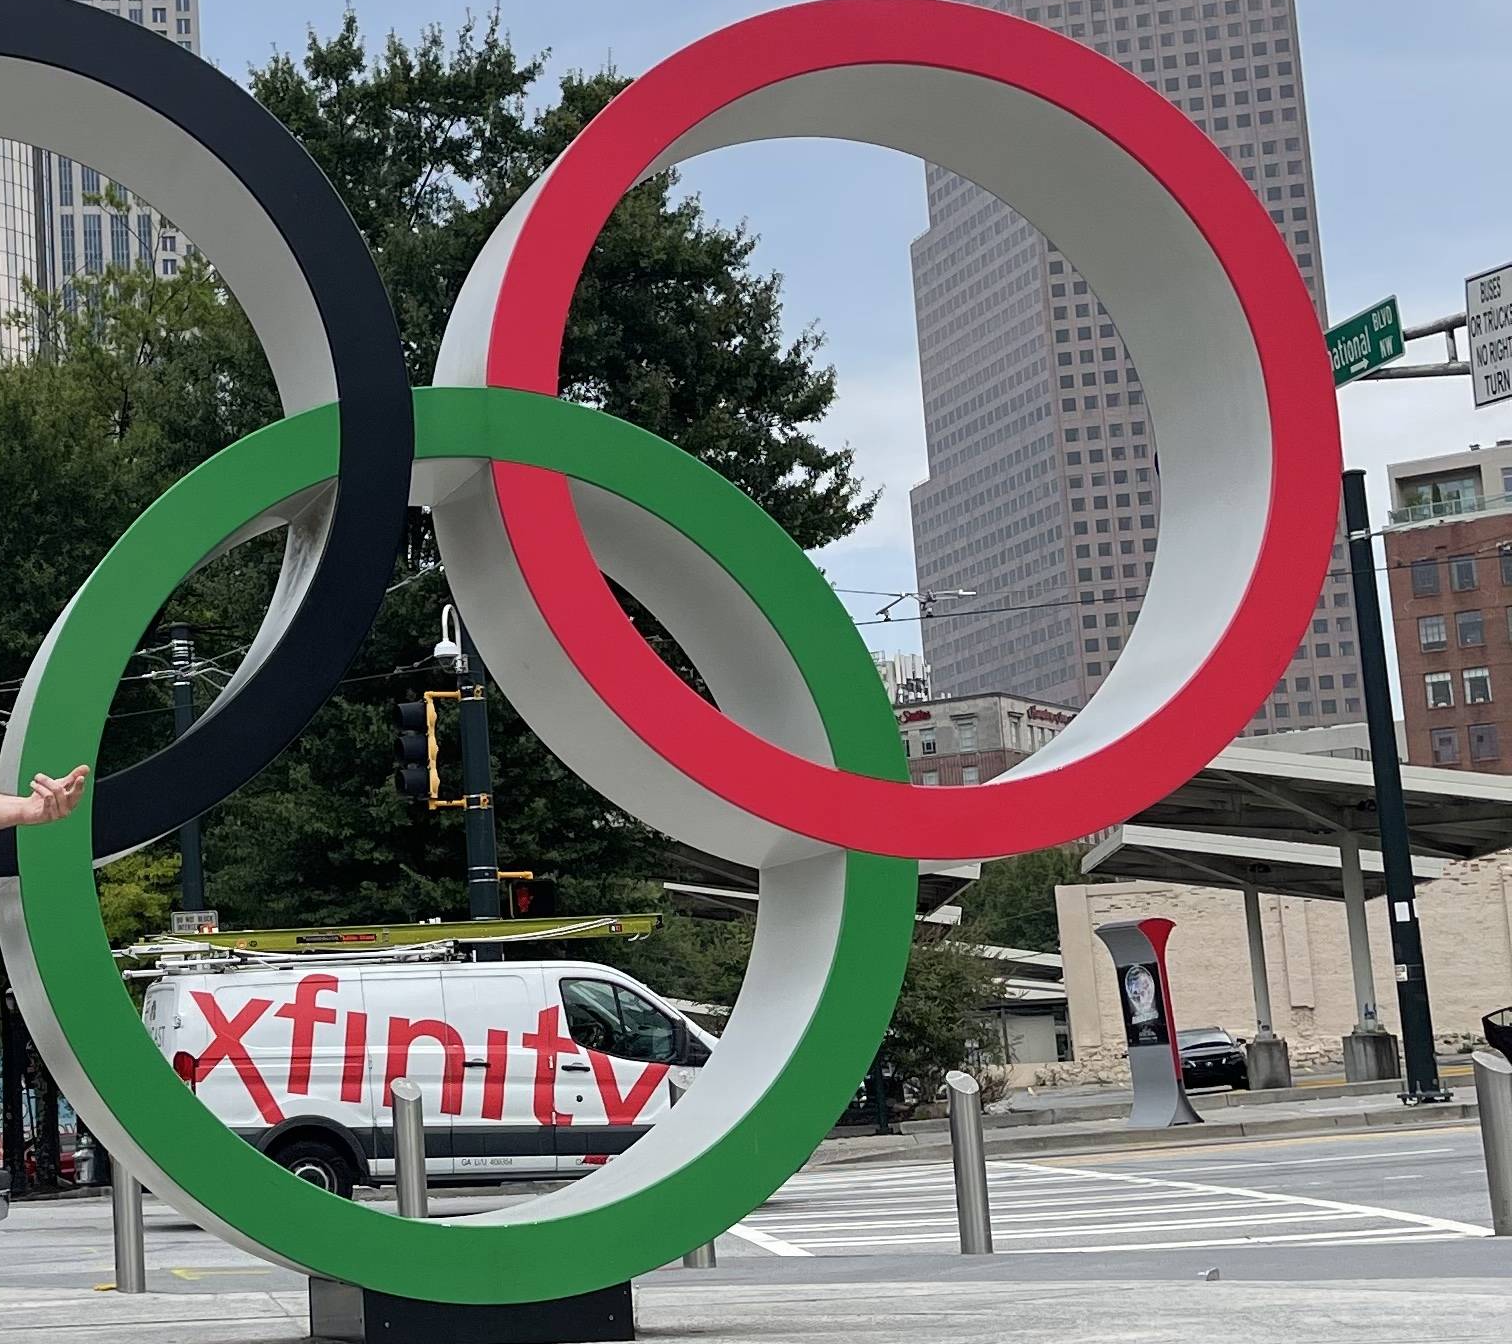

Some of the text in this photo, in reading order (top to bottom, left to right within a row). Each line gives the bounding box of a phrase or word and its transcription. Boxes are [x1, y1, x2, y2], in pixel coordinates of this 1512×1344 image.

[1479, 276, 1501, 304] BUSES
[1371, 305, 1393, 332] BLVD
[1470, 314, 1482, 338] OR
[1379, 335, 1394, 359] NW
[1475, 343, 1488, 368] NO
[1484, 369, 1511, 397] TURN
[189, 974, 671, 1164] xfinity
